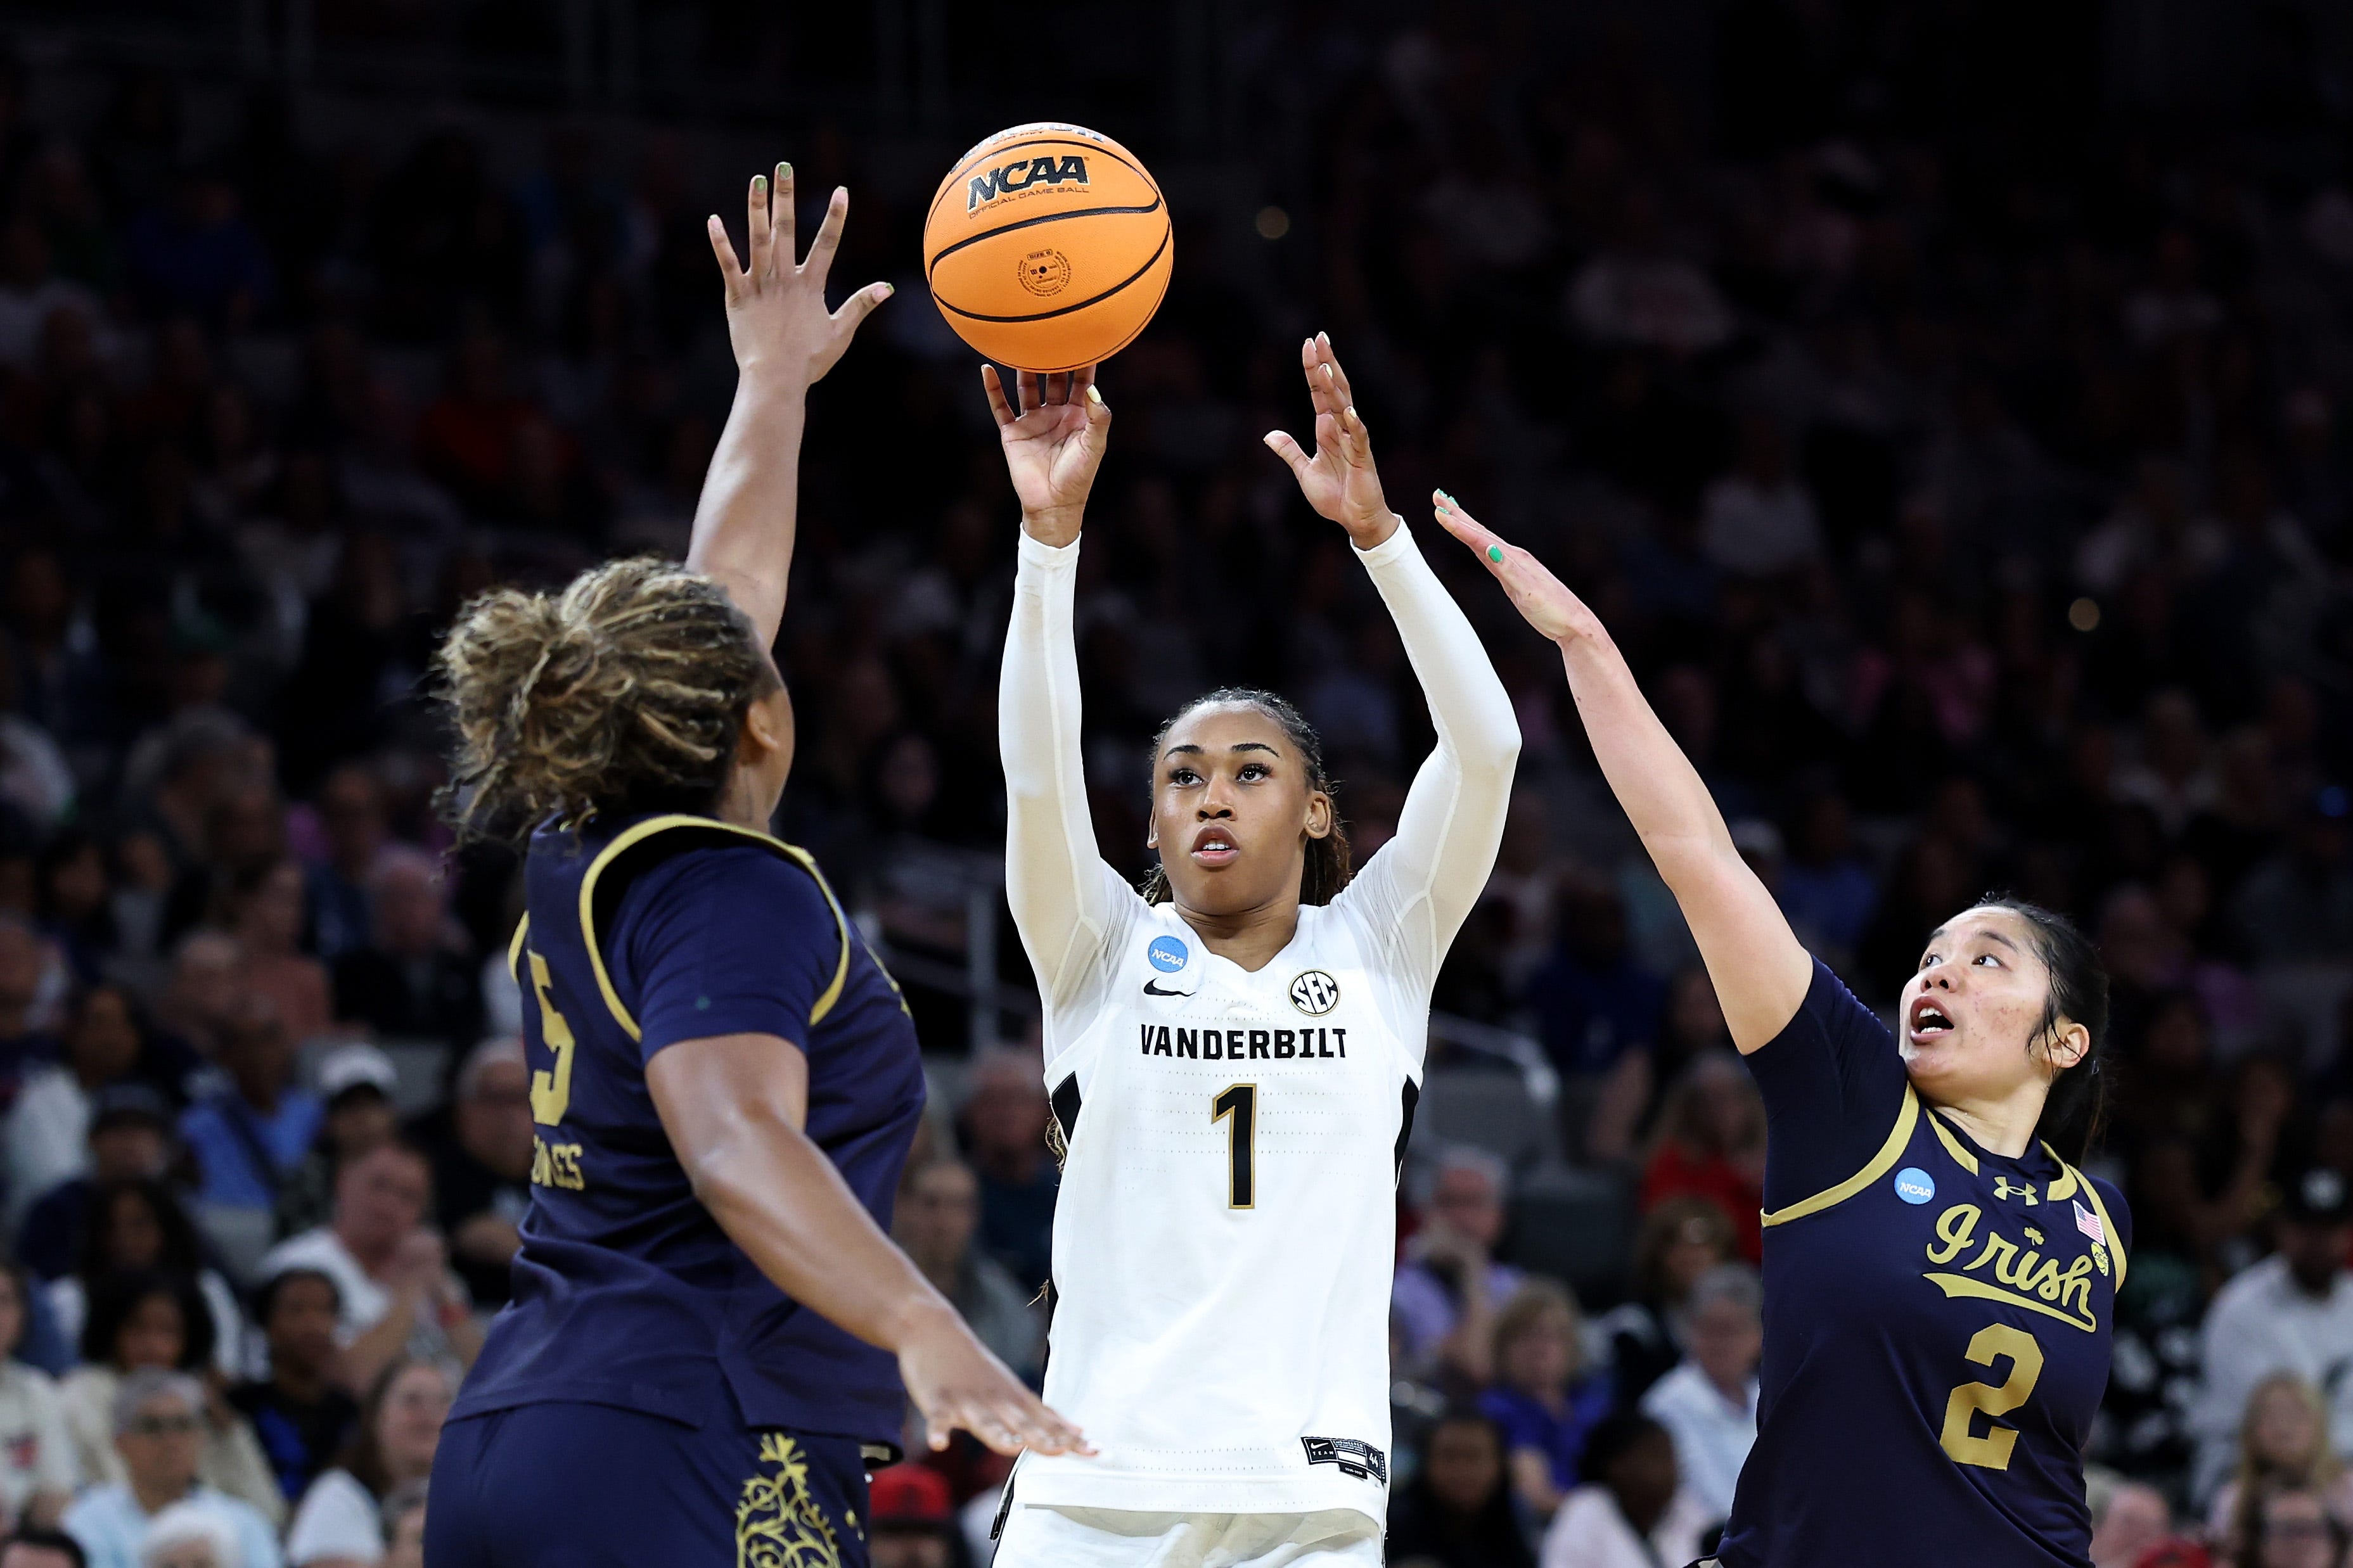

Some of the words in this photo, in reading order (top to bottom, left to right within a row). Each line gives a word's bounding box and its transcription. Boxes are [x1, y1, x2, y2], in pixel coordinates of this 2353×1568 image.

[967, 156, 1090, 213] NCAA
[969, 196, 1016, 220] OFFICIAL
[1019, 188, 1054, 199] GAME
[1151, 948, 1184, 968] NCAA
[1290, 971, 1338, 1015] SEC
[527, 949, 576, 1126] 5
[1140, 1024, 1347, 1060] VANDERBILT
[1211, 1083, 1257, 1209] 1
[1899, 1182, 1932, 1199] NCAA
[1927, 1204, 2096, 1316] Irish
[1939, 1323, 2044, 1471] 2
[1369, 1453, 1379, 1468] 44
